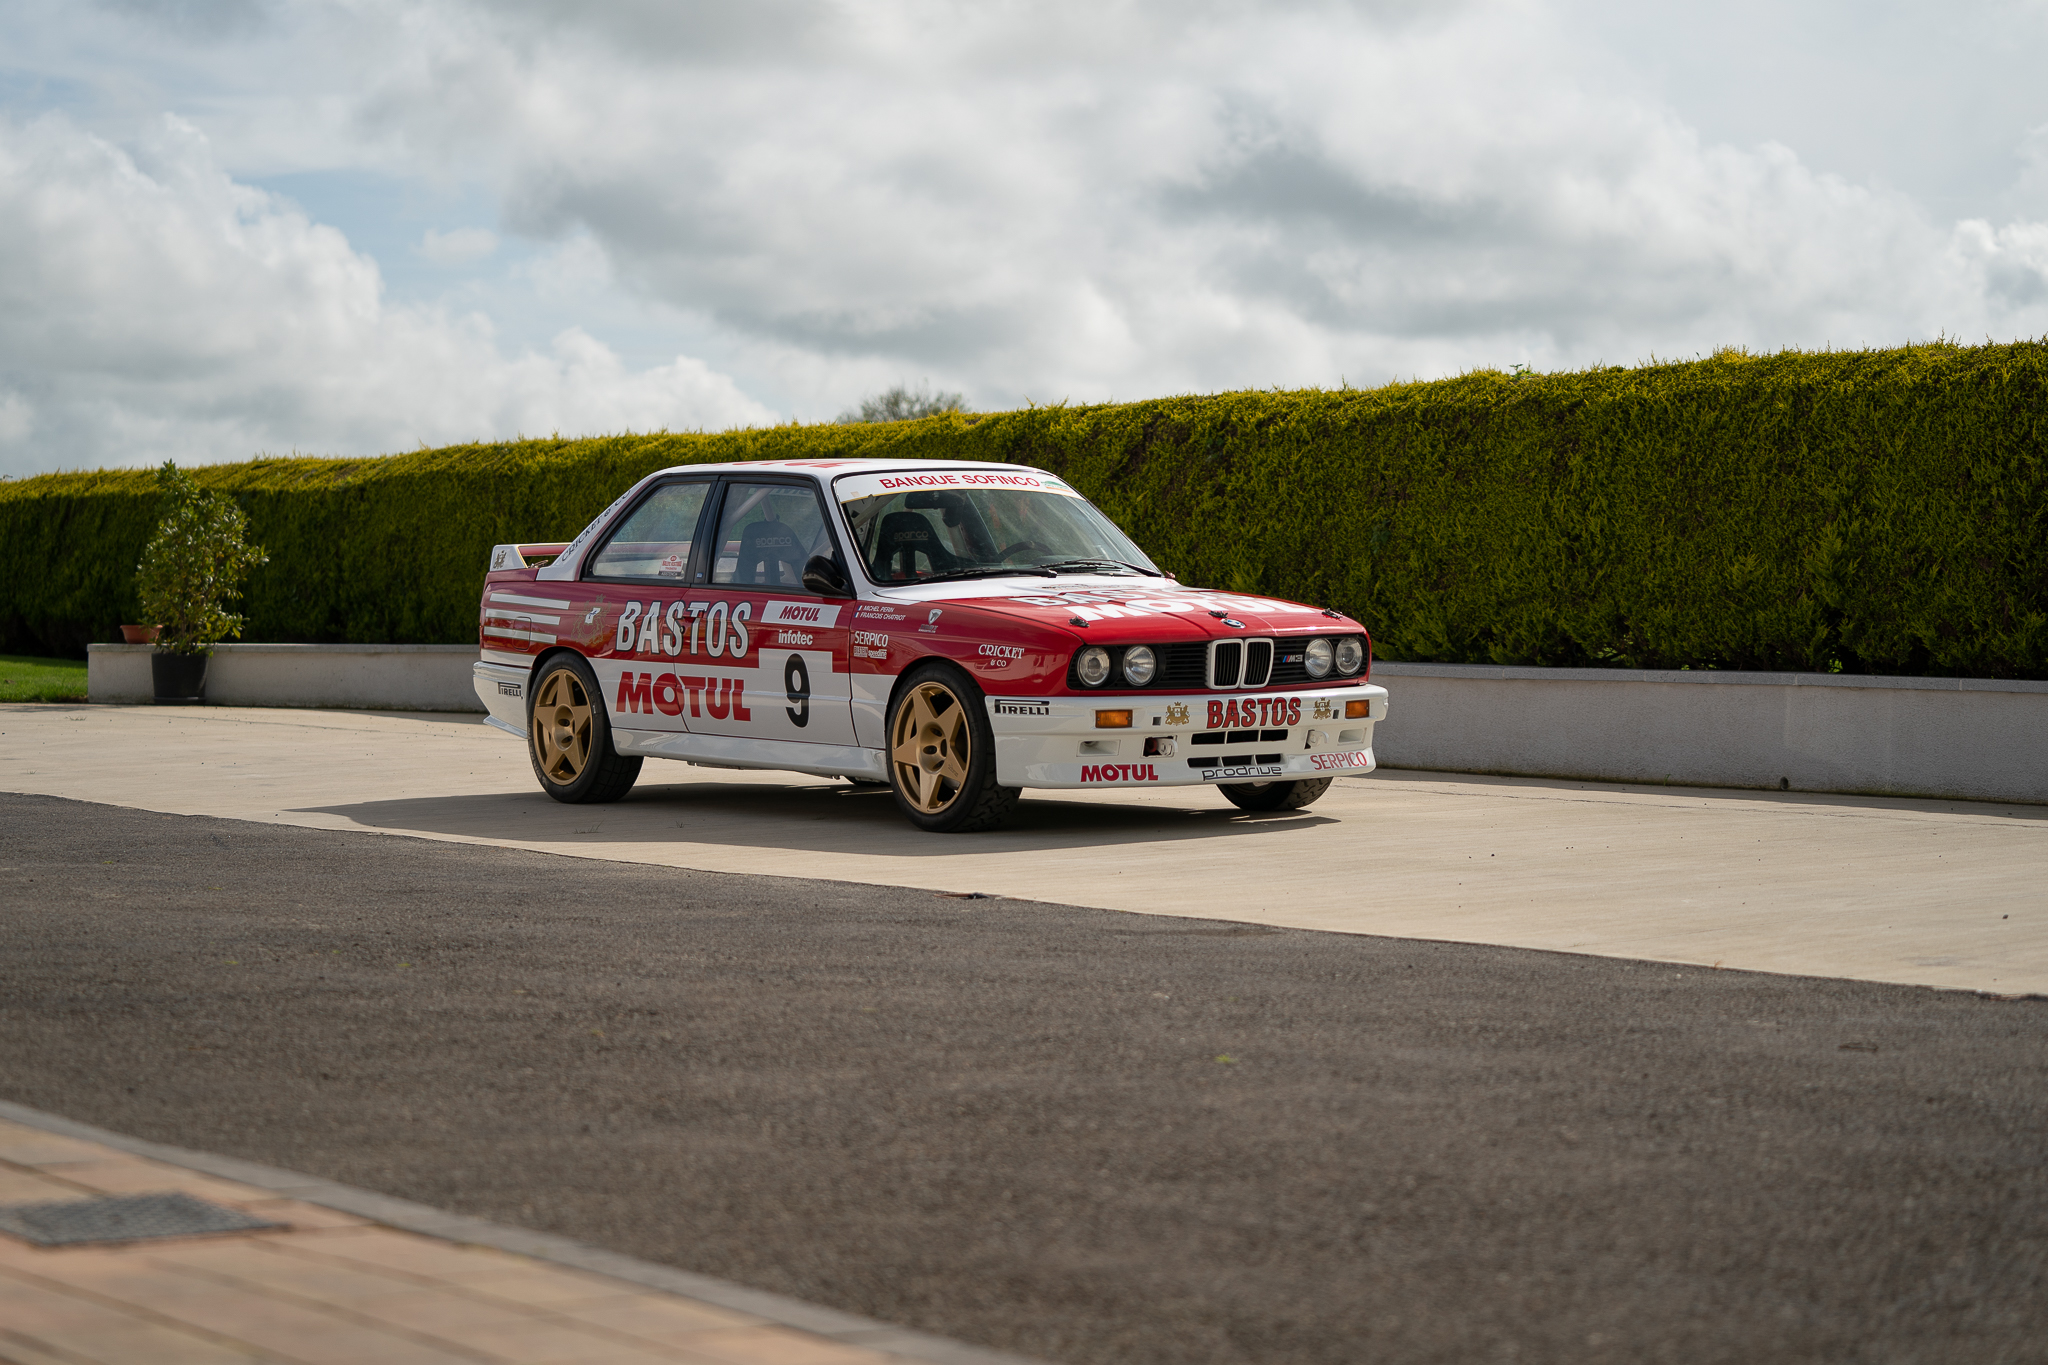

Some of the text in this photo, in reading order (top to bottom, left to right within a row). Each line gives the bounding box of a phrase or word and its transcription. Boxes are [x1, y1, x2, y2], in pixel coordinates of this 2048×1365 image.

[879, 475, 1041, 489] BANQUE SOFINCO
[561, 515, 603, 562] CRICKET
[778, 605, 821, 622] MOTUL
[1063, 599, 1316, 621] MOTUL
[615, 599, 753, 660] BASTOS
[778, 629, 813, 646] infotec
[854, 630, 889, 648] SERPICO
[978, 643, 1025, 660] CRICKET
[1288, 655, 1303, 663] M3
[996, 659, 1007, 668] CO
[498, 682, 522, 698] PIRELLI
[615, 671, 752, 722] MOTUL
[784, 653, 811, 728] 9
[994, 698, 1050, 716] PIRELLI
[1206, 696, 1302, 730] BASTOS
[1309, 751, 1368, 771] SERPICO
[1080, 763, 1159, 783] MOTUL
[1201, 765, 1283, 782] prodrive
